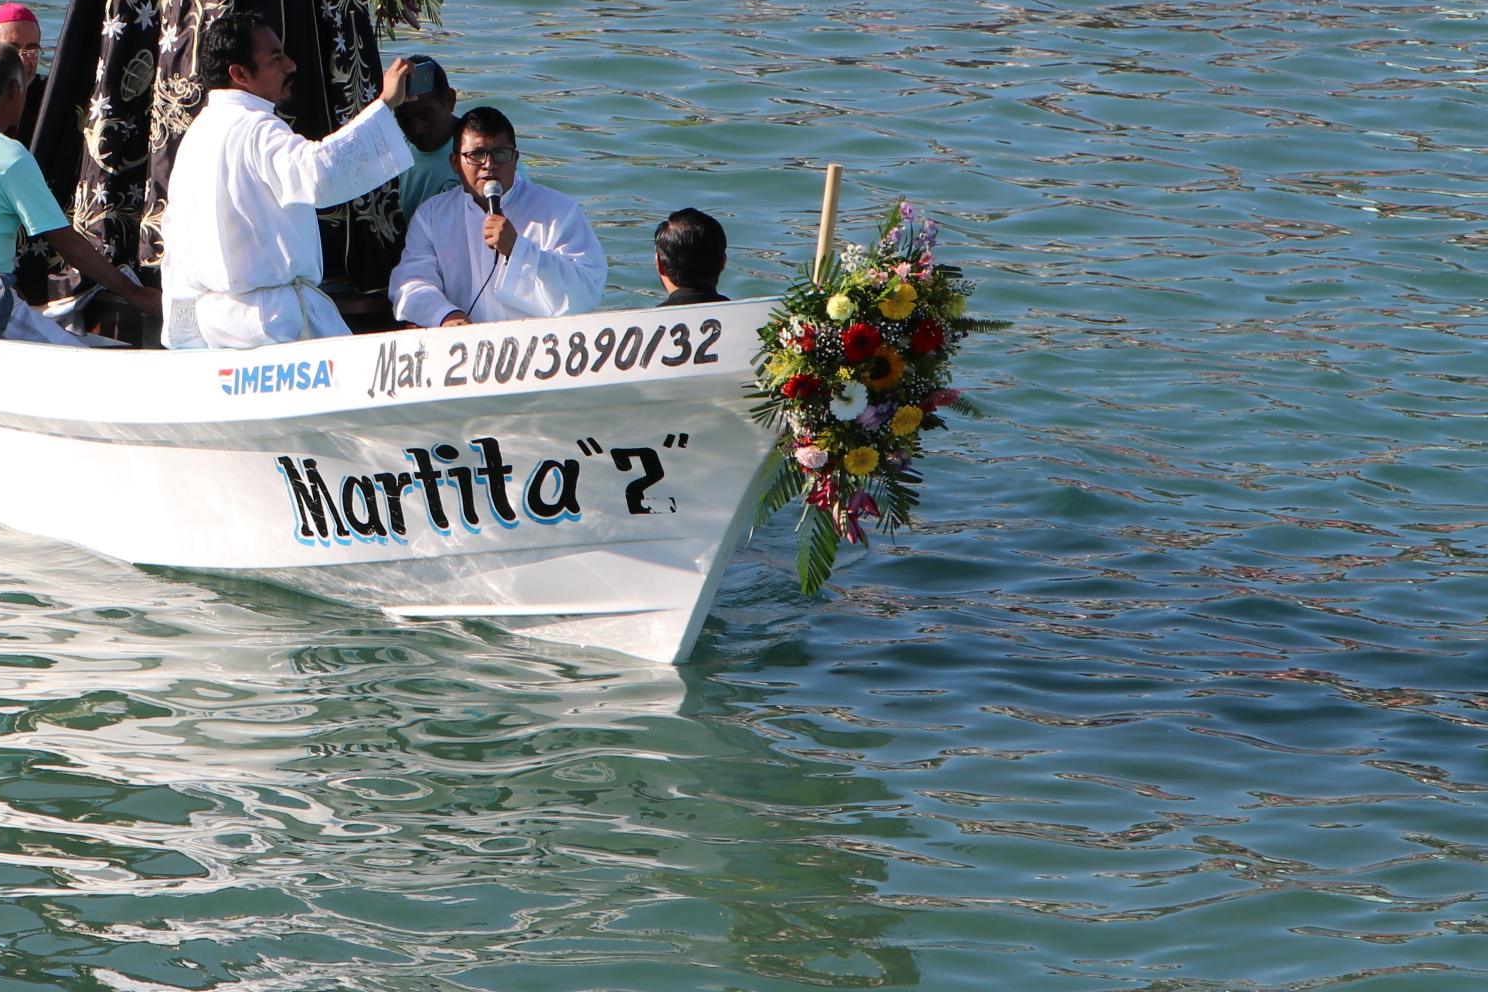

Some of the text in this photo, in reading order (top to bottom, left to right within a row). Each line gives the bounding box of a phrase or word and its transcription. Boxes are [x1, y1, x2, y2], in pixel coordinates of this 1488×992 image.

[234, 318, 722, 399] IMEMSA Mat. 200/3890/32
[276, 436, 582, 547] Martita
